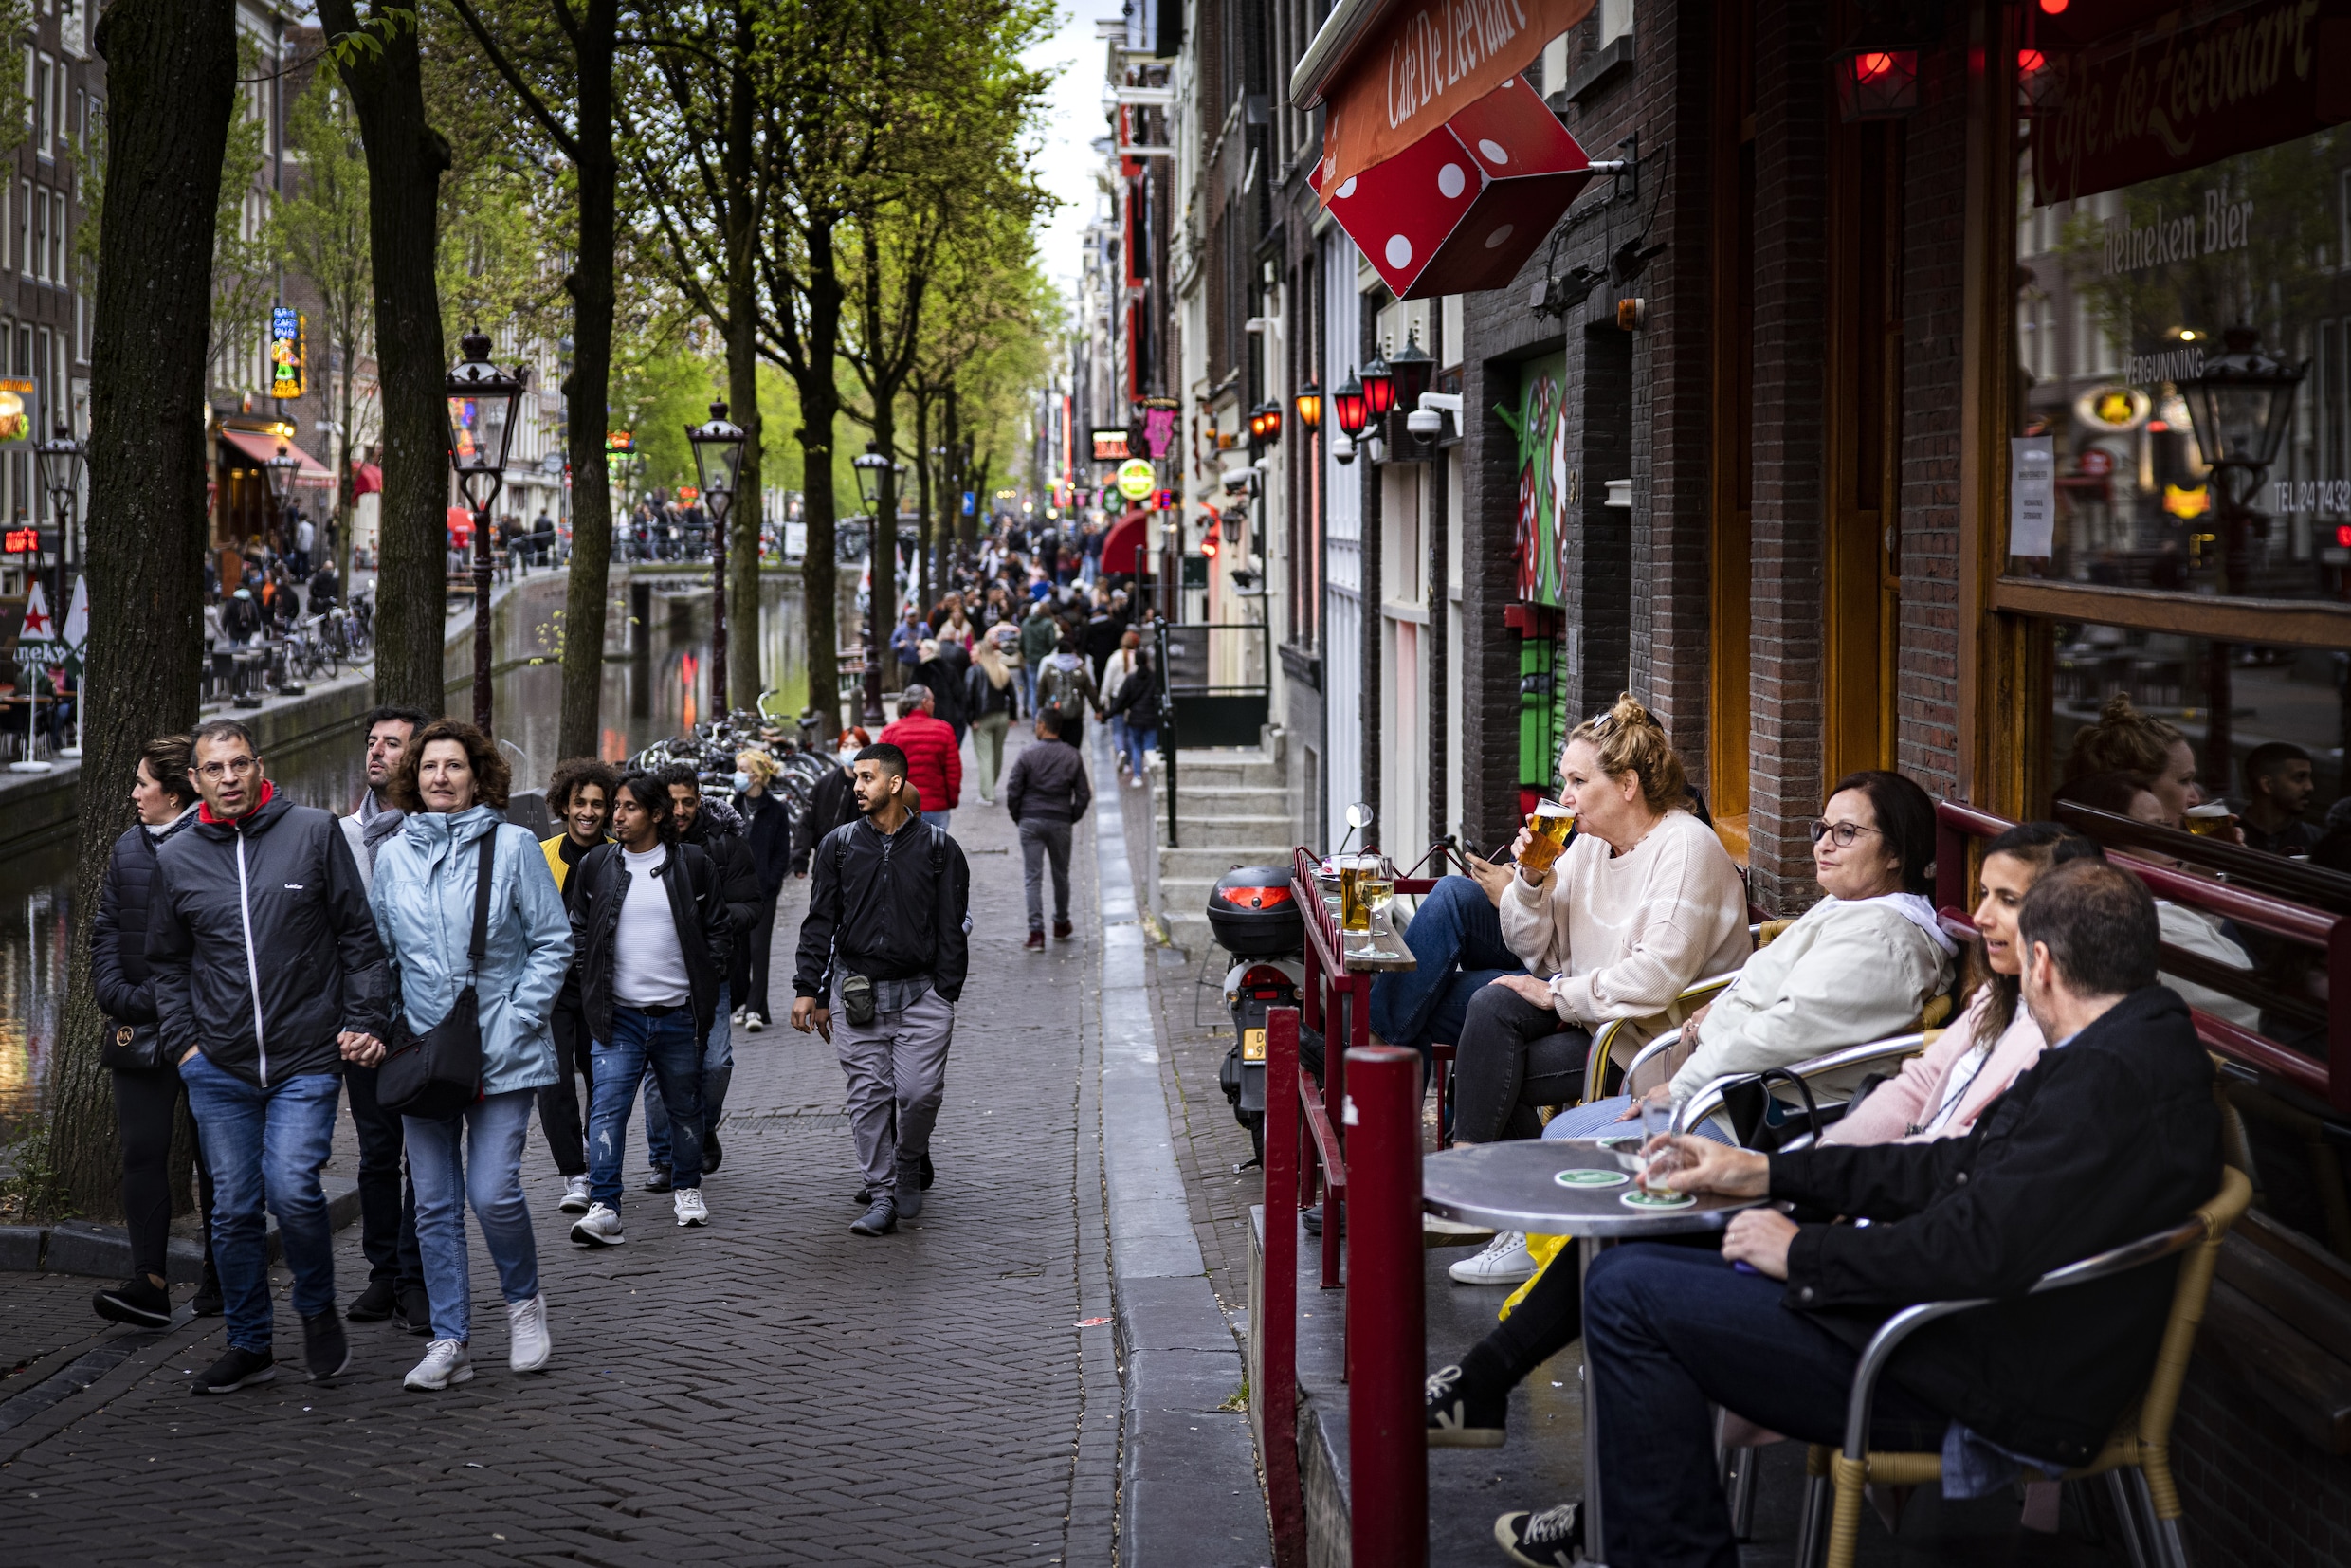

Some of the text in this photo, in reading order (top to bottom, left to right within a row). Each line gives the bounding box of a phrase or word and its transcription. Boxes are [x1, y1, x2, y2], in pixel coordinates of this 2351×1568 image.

[1388, 17, 1417, 130] Café
[1416, 9, 1443, 106] De
[2103, 187, 2254, 275] Heineken Bier
[2125, 348, 2204, 386] VERGUNNING
